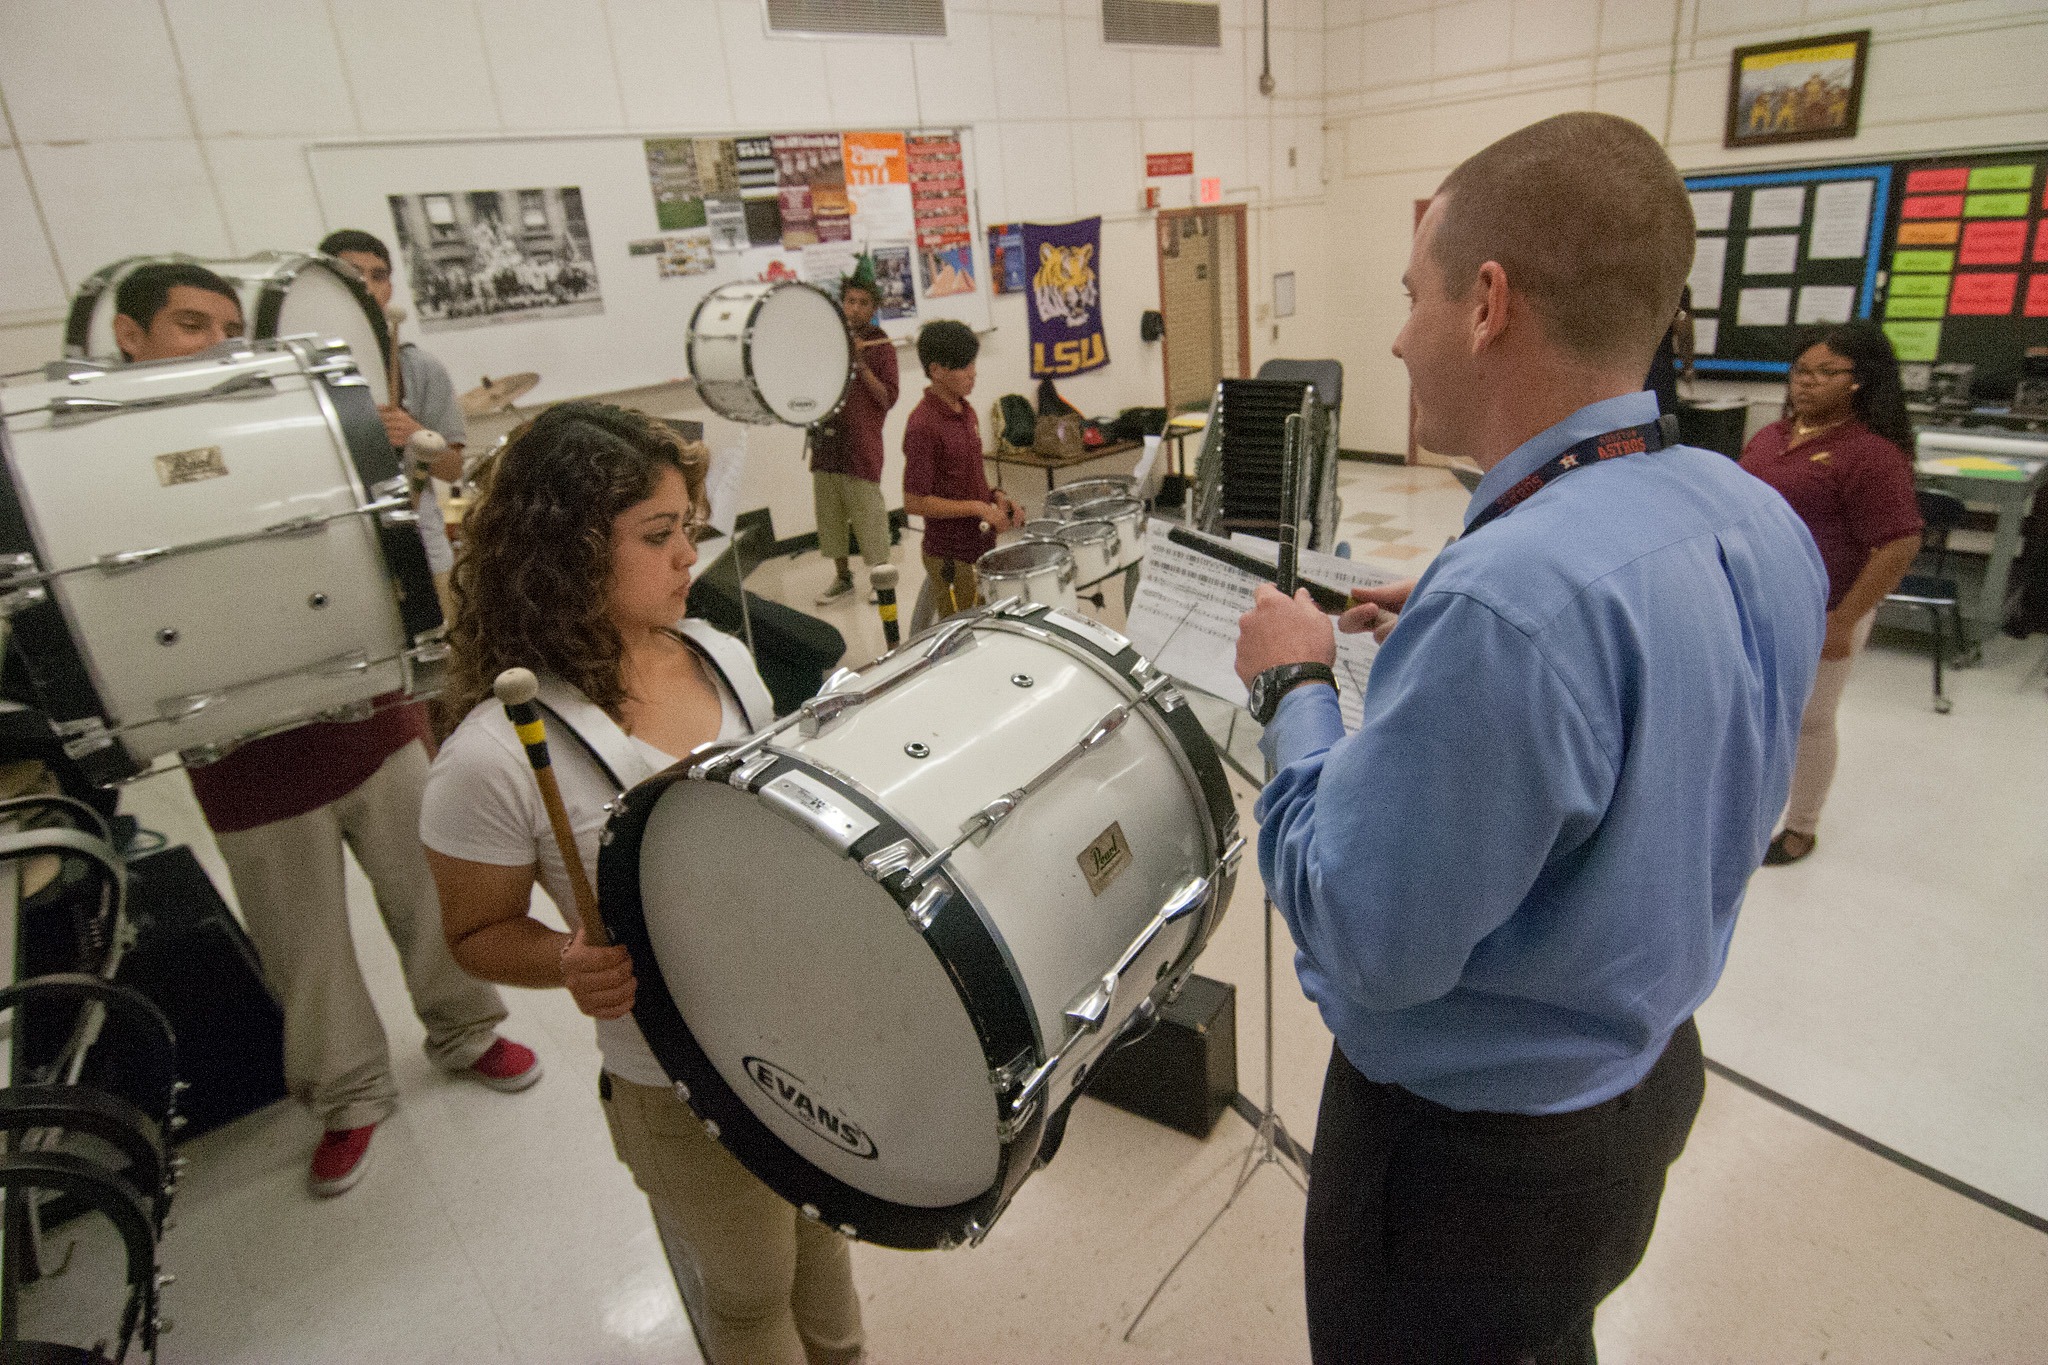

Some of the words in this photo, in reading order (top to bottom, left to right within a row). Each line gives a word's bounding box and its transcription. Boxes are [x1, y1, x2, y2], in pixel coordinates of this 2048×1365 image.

[1033, 332, 1104, 373] LSU
[1597, 437, 1647, 460] ASTROS
[1090, 834, 1118, 877] Pearl
[757, 1064, 860, 1147] EVANS
